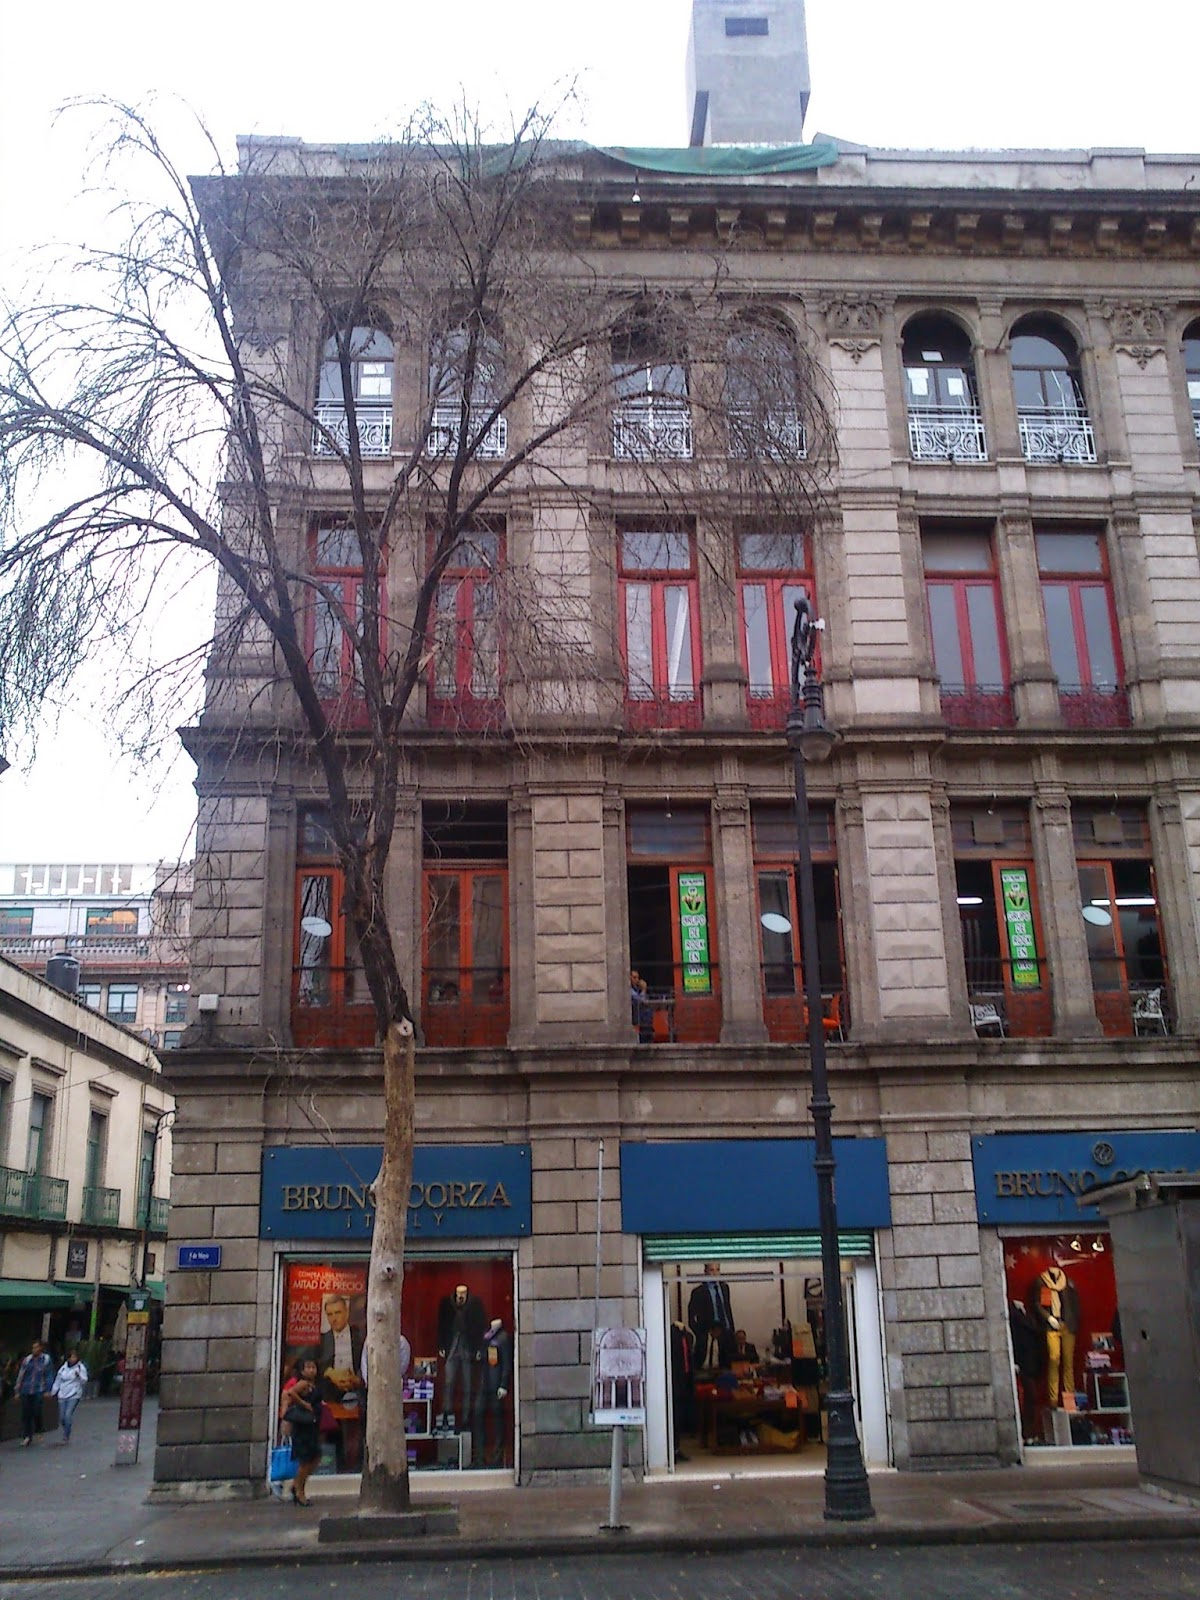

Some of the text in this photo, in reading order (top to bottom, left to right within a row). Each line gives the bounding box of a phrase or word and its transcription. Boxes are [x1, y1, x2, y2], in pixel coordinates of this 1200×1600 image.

[686, 941, 704, 949] ROCK
[994, 1169, 1096, 1197] BRUNO
[281, 1182, 511, 1211] BRUN CORZA
[346, 1213, 443, 1228] ITLY
[293, 1280, 363, 1290] MITAD DE PRECIO
[292, 1301, 320, 1312] TRAJES
[290, 1313, 320, 1323] SACOS
